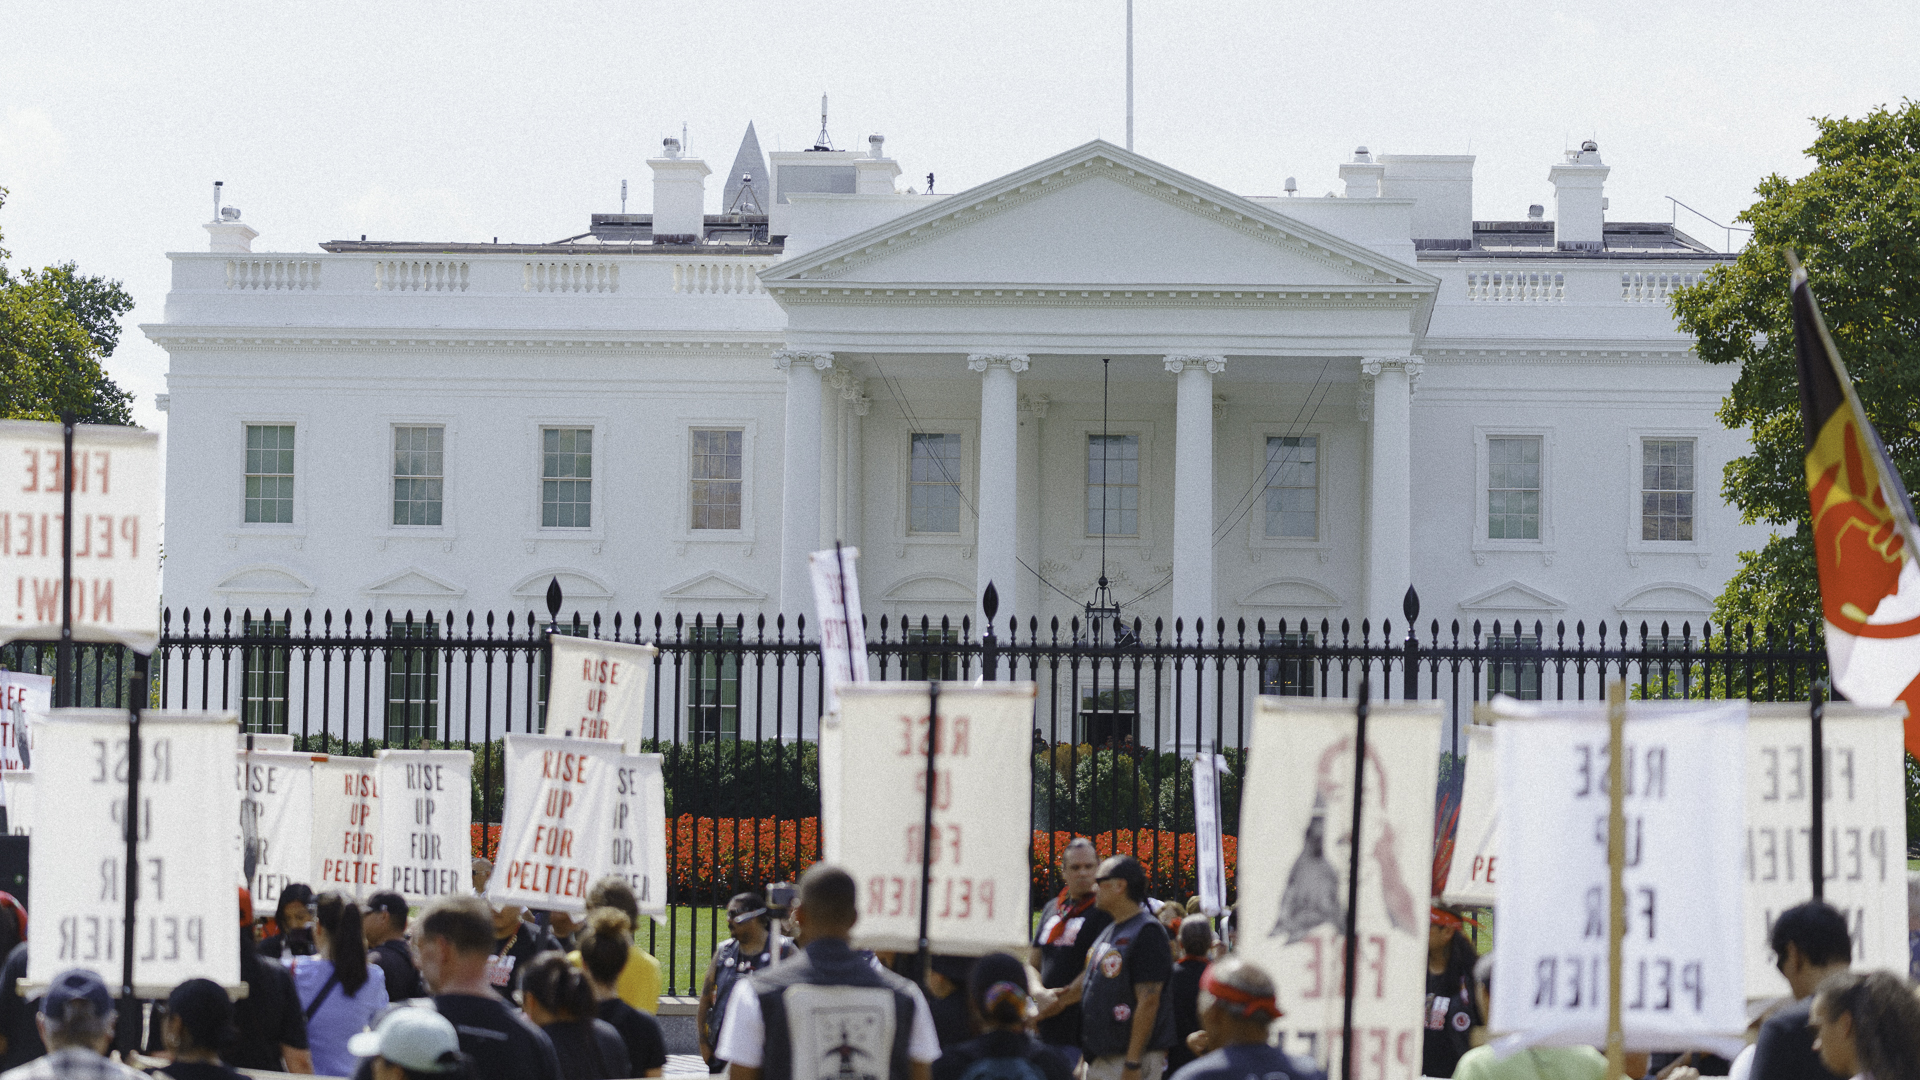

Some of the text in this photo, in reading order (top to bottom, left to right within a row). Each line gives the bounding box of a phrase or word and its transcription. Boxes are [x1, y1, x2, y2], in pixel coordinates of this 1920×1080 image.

[583, 659, 621, 685] RISE
[588, 689, 607, 712] UP
[579, 717, 610, 740] FOR
[406, 763, 444, 791] RISE
[542, 750, 588, 784] RISE
[350, 803, 370, 826] UP
[415, 797, 436, 825] UP
[547, 788, 573, 819] UP
[343, 831, 373, 856] FOR
[411, 832, 442, 860] FOR
[534, 825, 574, 858] FOR
[323, 858, 380, 885] PELTIE
[392, 866, 459, 896] PELTIER
[506, 859, 589, 899] PELTIER
